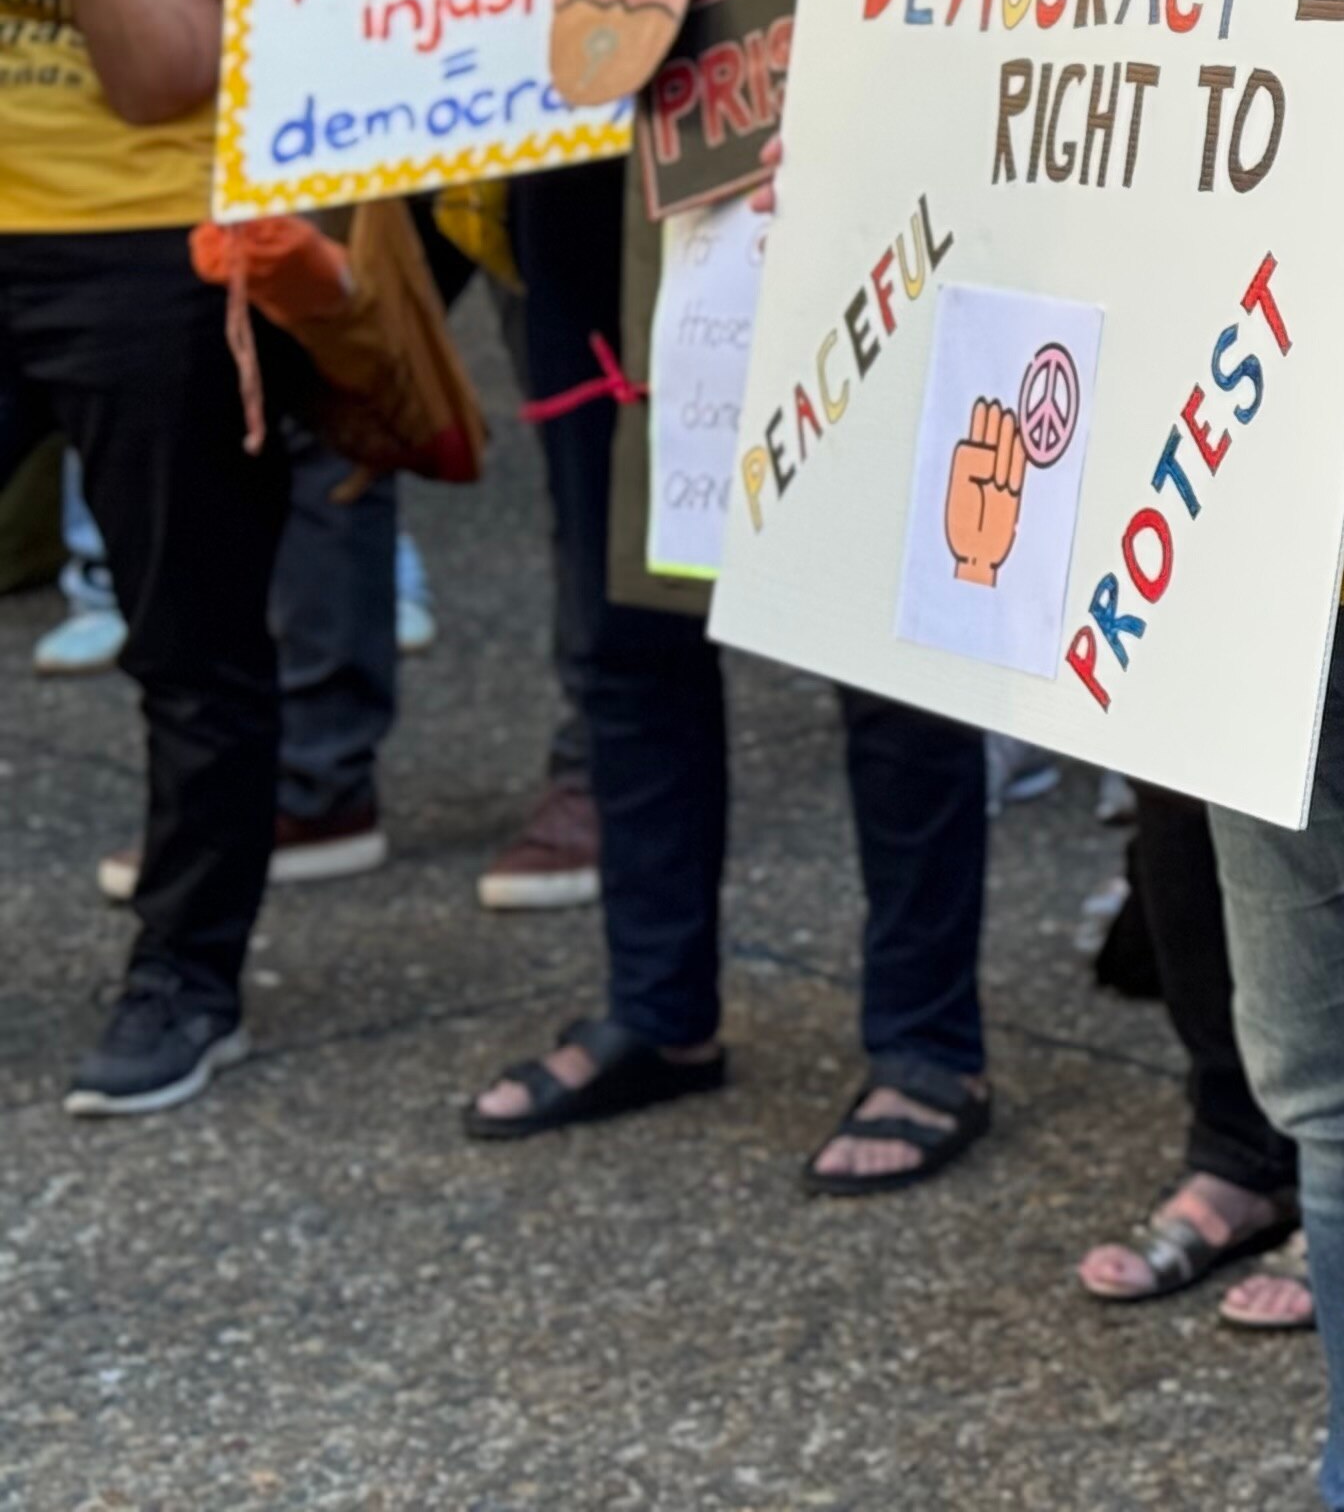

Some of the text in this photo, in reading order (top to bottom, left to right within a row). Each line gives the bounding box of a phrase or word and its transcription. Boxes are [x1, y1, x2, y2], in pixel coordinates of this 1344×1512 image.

[992, 58, 1286, 194] RIGHT TO
[741, 193, 954, 534] PEACEFUL
[1065, 250, 1292, 714] PROTEST
